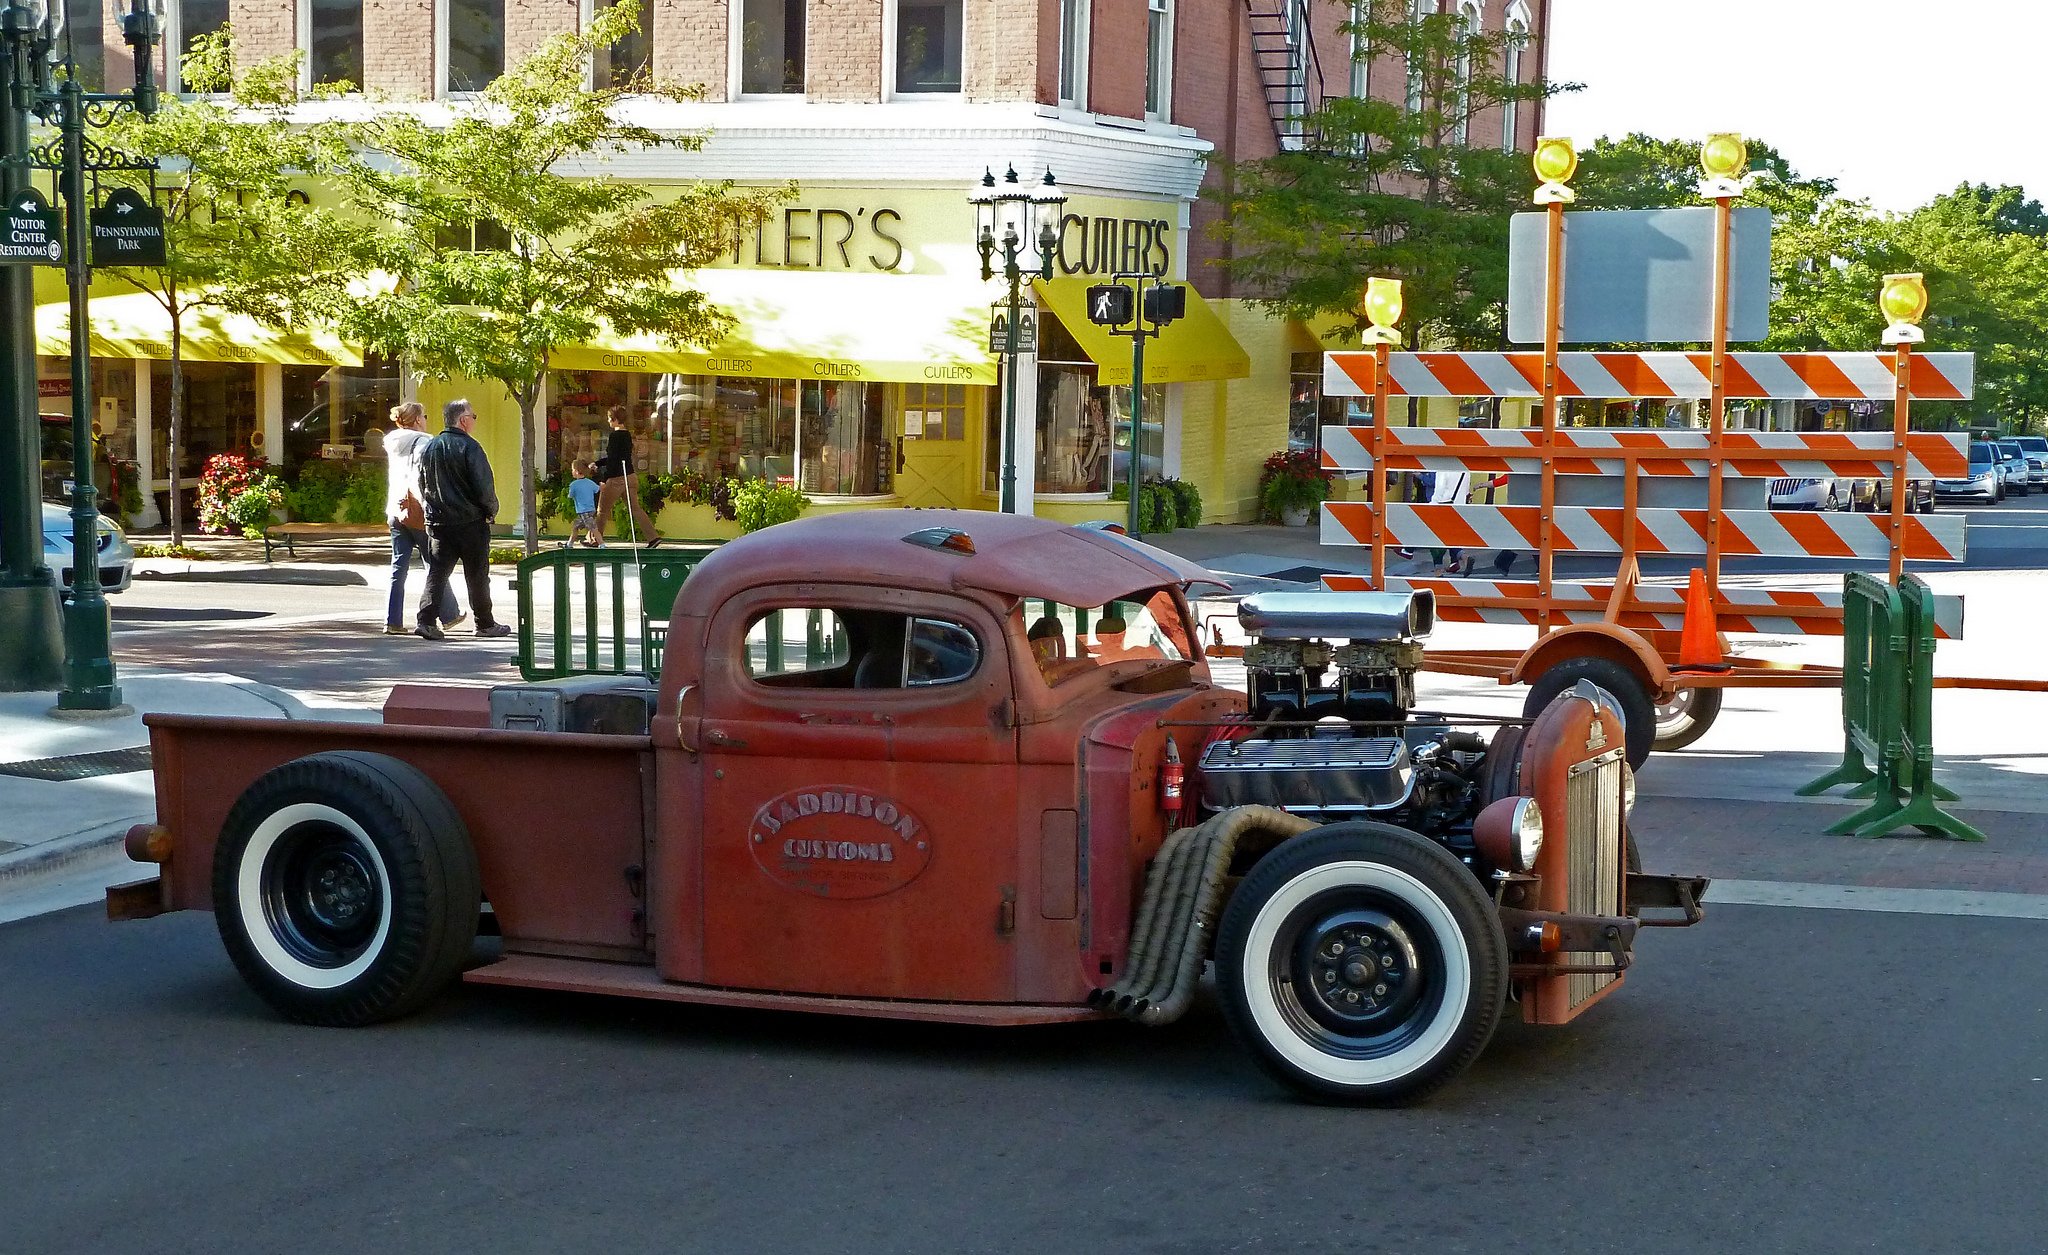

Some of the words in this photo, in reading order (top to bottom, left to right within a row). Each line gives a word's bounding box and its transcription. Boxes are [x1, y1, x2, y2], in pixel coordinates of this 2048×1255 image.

[9, 217, 47, 230] VISITOR
[11, 230, 47, 243] CENTER
[95, 225, 160, 237] PENNSYLVANIA
[117, 239, 141, 250] PARK
[1058, 213, 1169, 277] CUTLER'S
[760, 791, 920, 841] SADDISON
[783, 838, 893, 862] CUSTOMS
